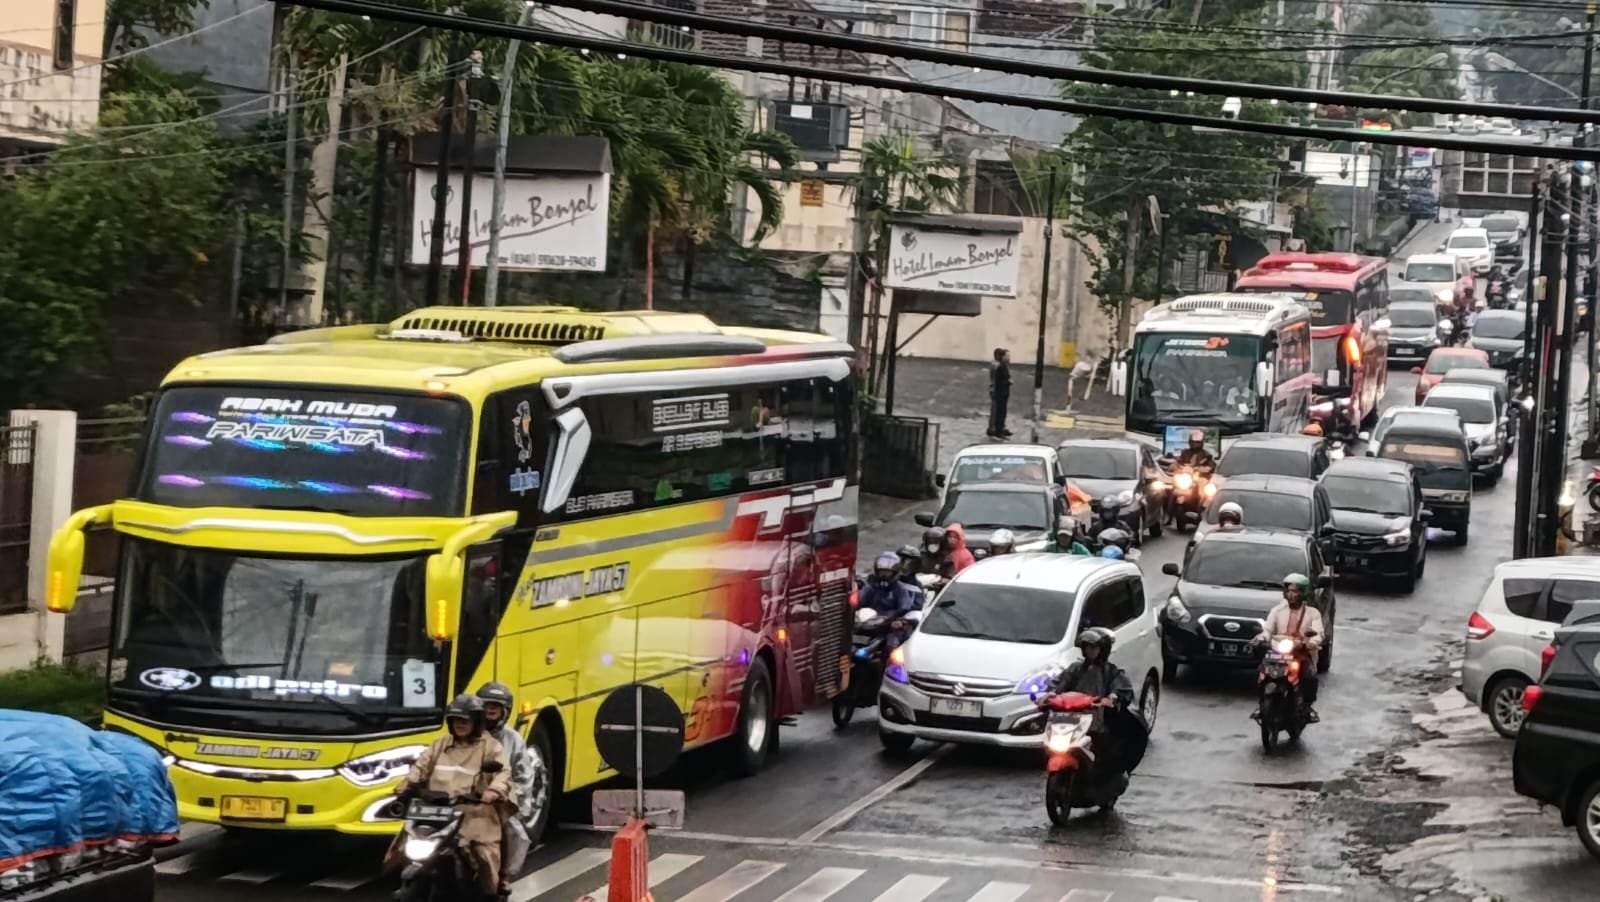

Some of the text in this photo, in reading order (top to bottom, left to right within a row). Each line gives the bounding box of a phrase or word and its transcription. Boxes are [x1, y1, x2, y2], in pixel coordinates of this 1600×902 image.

[528, 184, 598, 227] Bonjol
[893, 238, 1014, 277] Hotel Imam Bonjol
[220, 397, 303, 413] ABAH
[306, 400, 397, 418] MUDA
[206, 420, 385, 449] PARIWISATA
[413, 677, 427, 696] 3
[261, 747, 299, 761] JAYA
